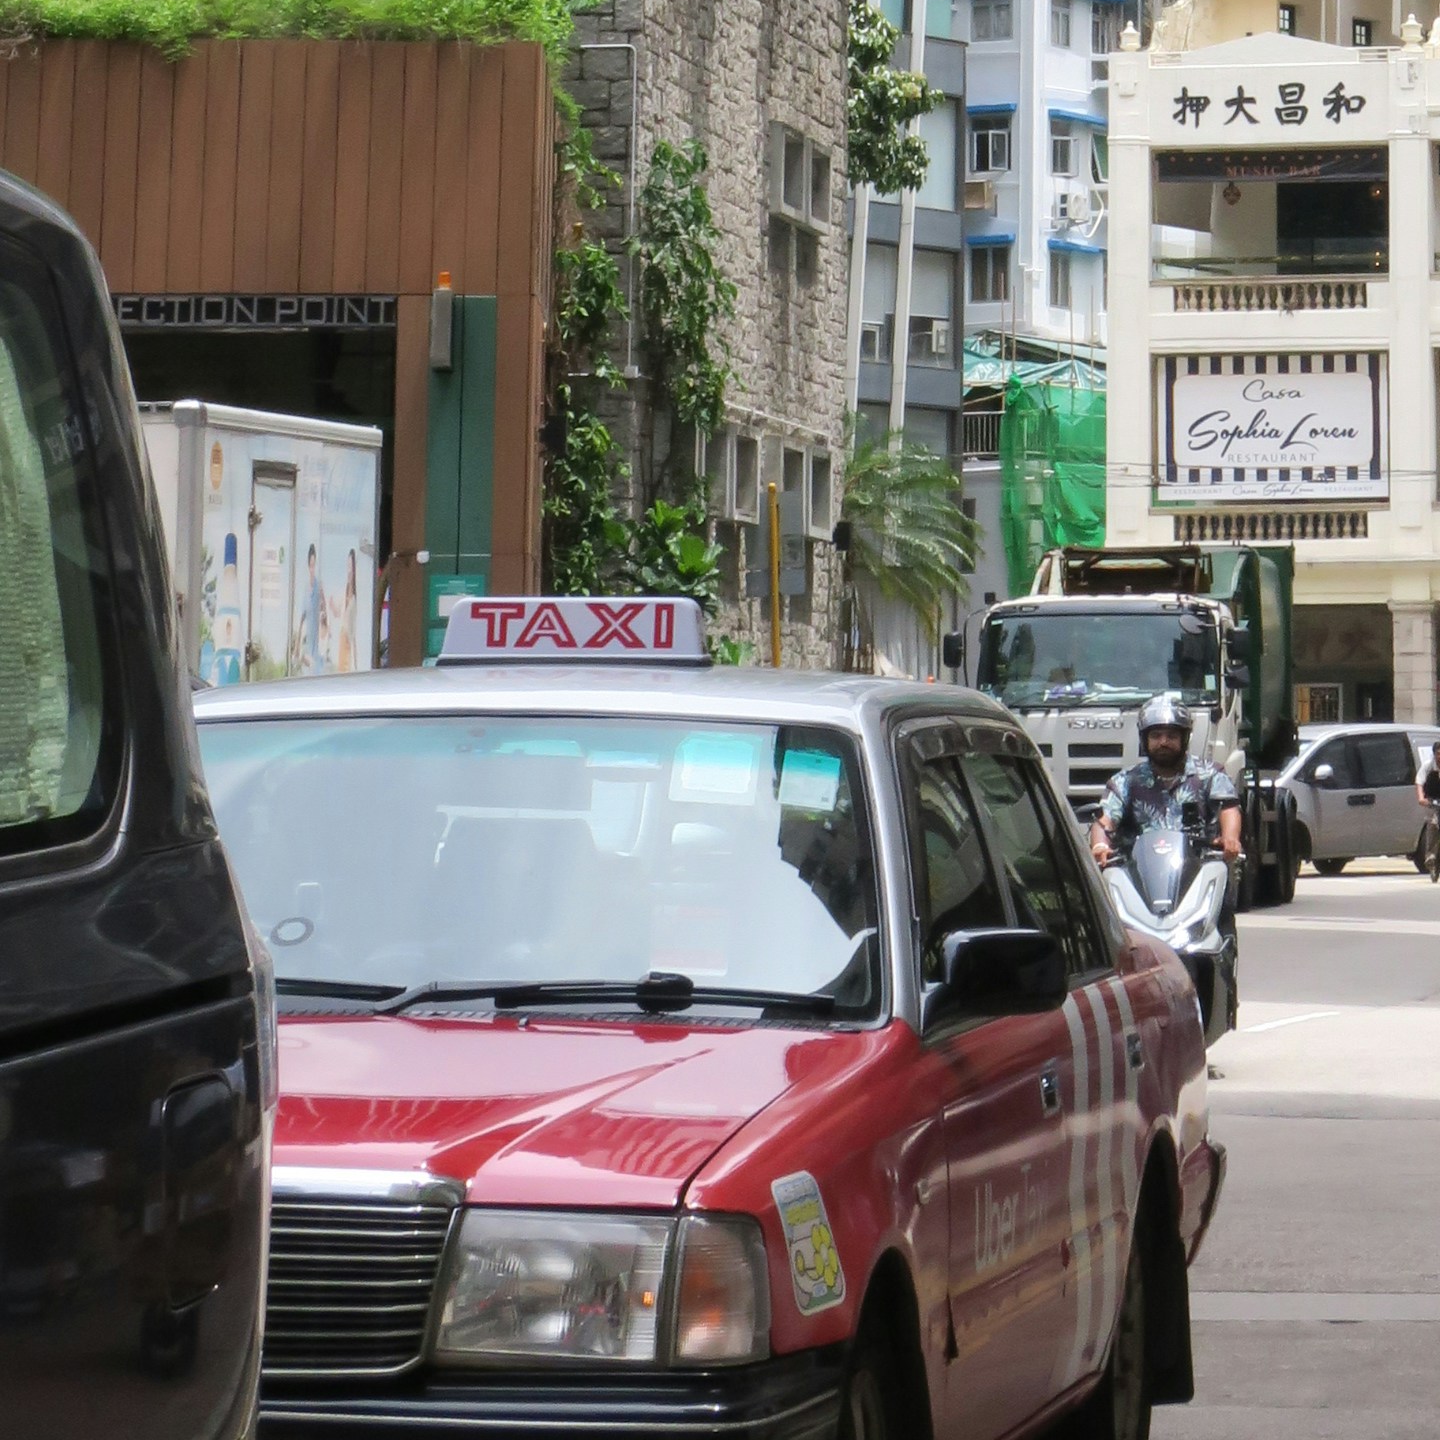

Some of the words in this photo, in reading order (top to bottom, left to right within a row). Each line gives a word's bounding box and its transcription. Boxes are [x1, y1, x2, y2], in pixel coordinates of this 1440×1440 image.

[1226, 165, 1279, 177] MUSIC
[1288, 165, 1322, 176] BAR
[274, 295, 396, 326] POINT
[1242, 378, 1304, 403] Casa
[1187, 408, 1283, 459] Sophia
[1279, 412, 1360, 452] Loren
[1226, 452, 1318, 464] RESTAURANT
[471, 602, 675, 649] TAXI
[1067, 716, 1124, 730] ISUZU
